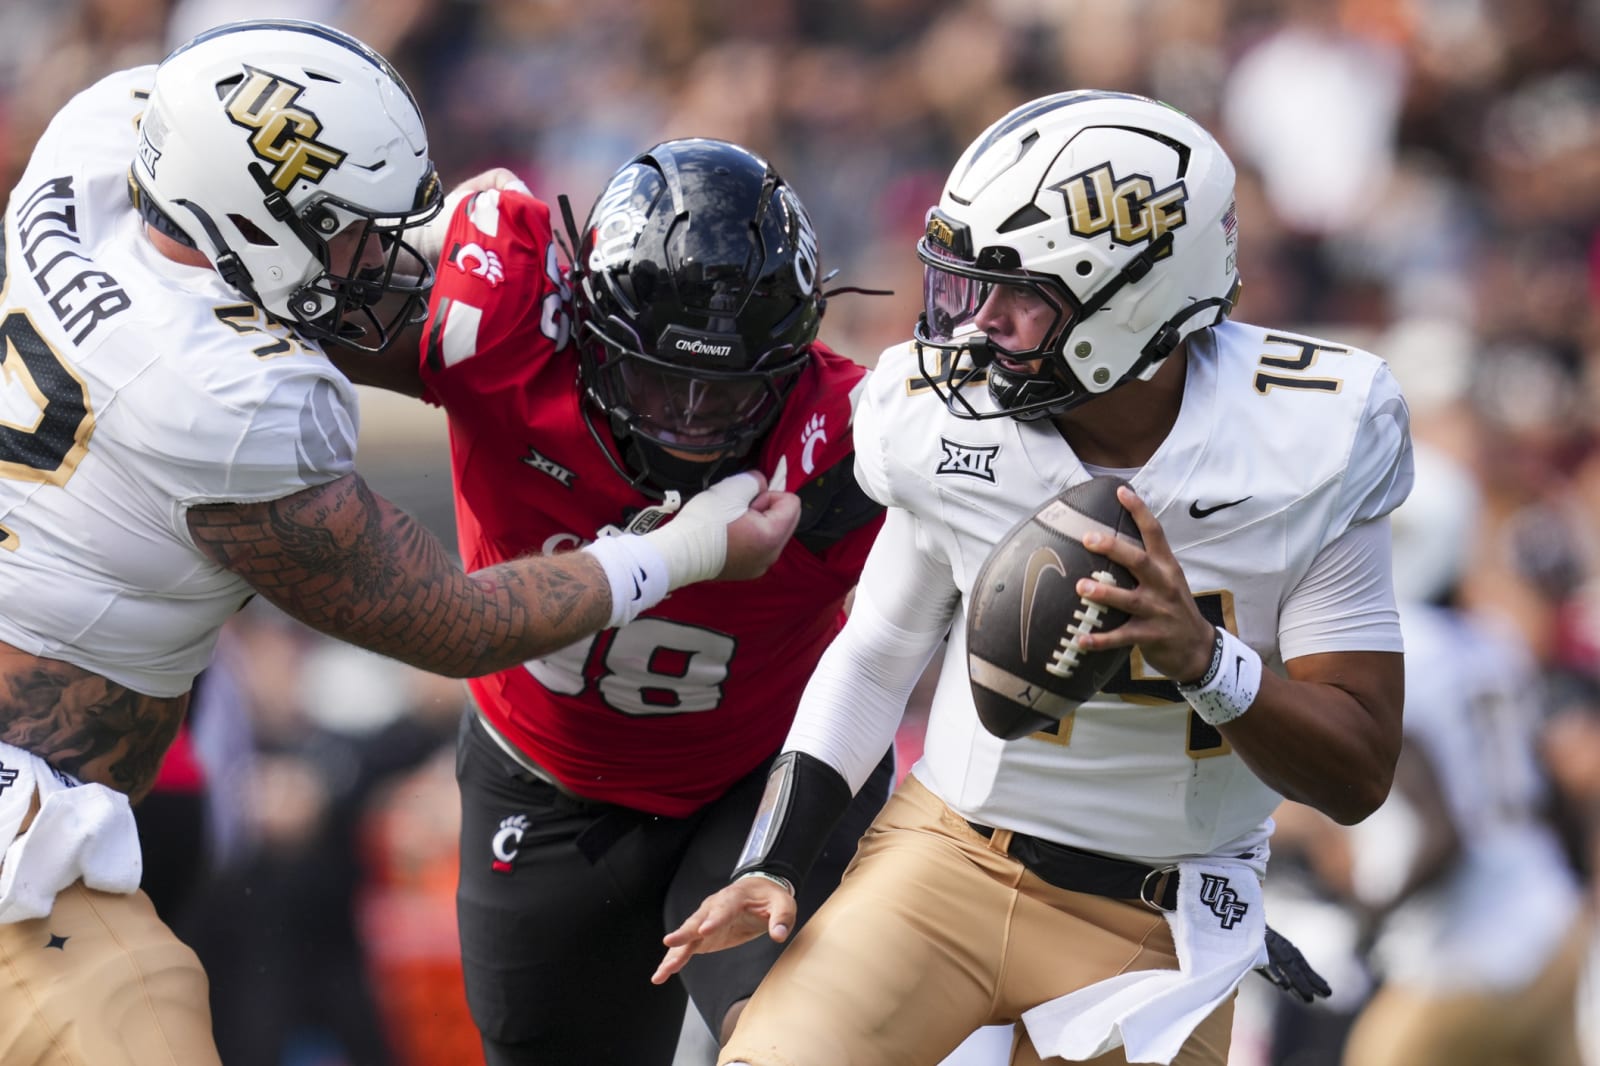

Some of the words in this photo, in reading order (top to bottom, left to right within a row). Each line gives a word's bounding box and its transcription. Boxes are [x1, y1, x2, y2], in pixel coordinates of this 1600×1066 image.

[224, 63, 349, 192] UCF
[1046, 161, 1189, 256] UCF
[16, 176, 132, 347] MILLER
[675, 339, 732, 356] CINCINNATI
[1253, 333, 1353, 396] 14
[1200, 873, 1248, 930] UCF
